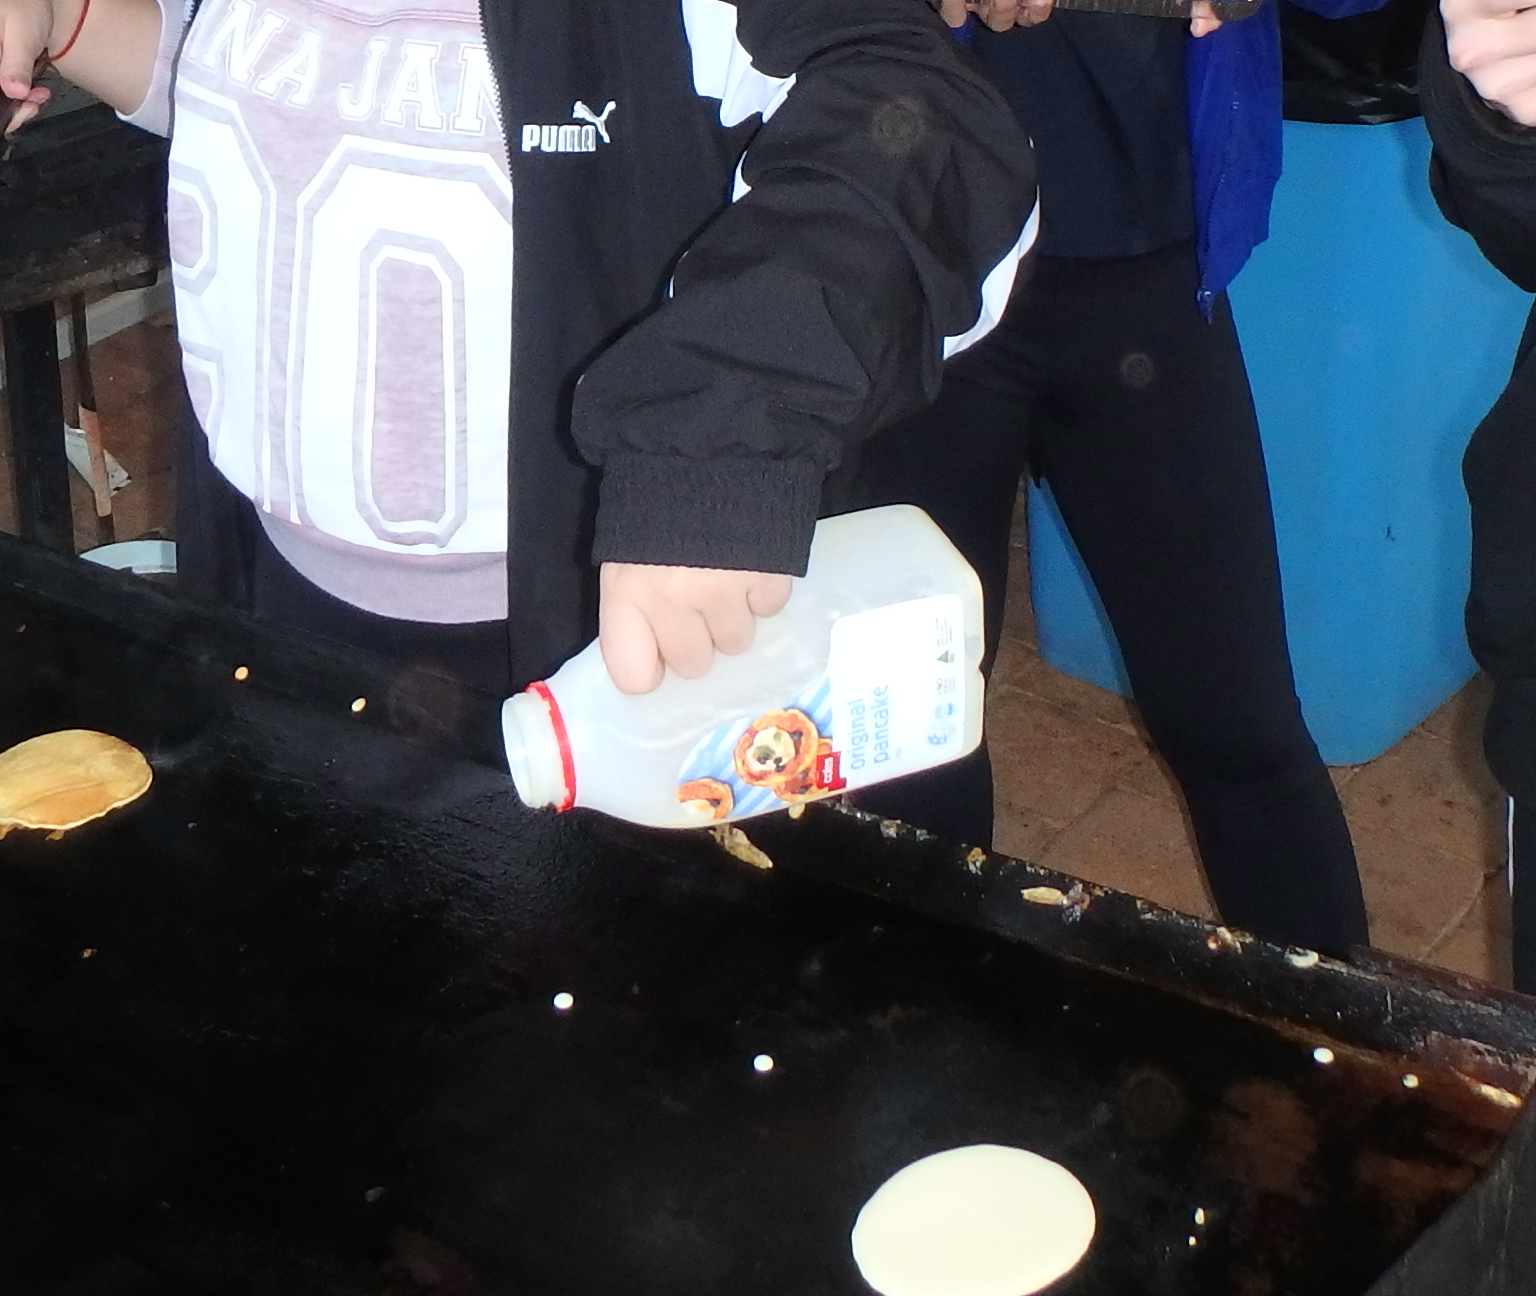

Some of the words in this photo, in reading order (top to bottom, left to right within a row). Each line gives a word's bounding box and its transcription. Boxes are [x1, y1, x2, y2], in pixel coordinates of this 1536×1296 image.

[521, 124, 597, 153] PUMA
[845, 698, 869, 770] original
[869, 684, 891, 764] pancake
